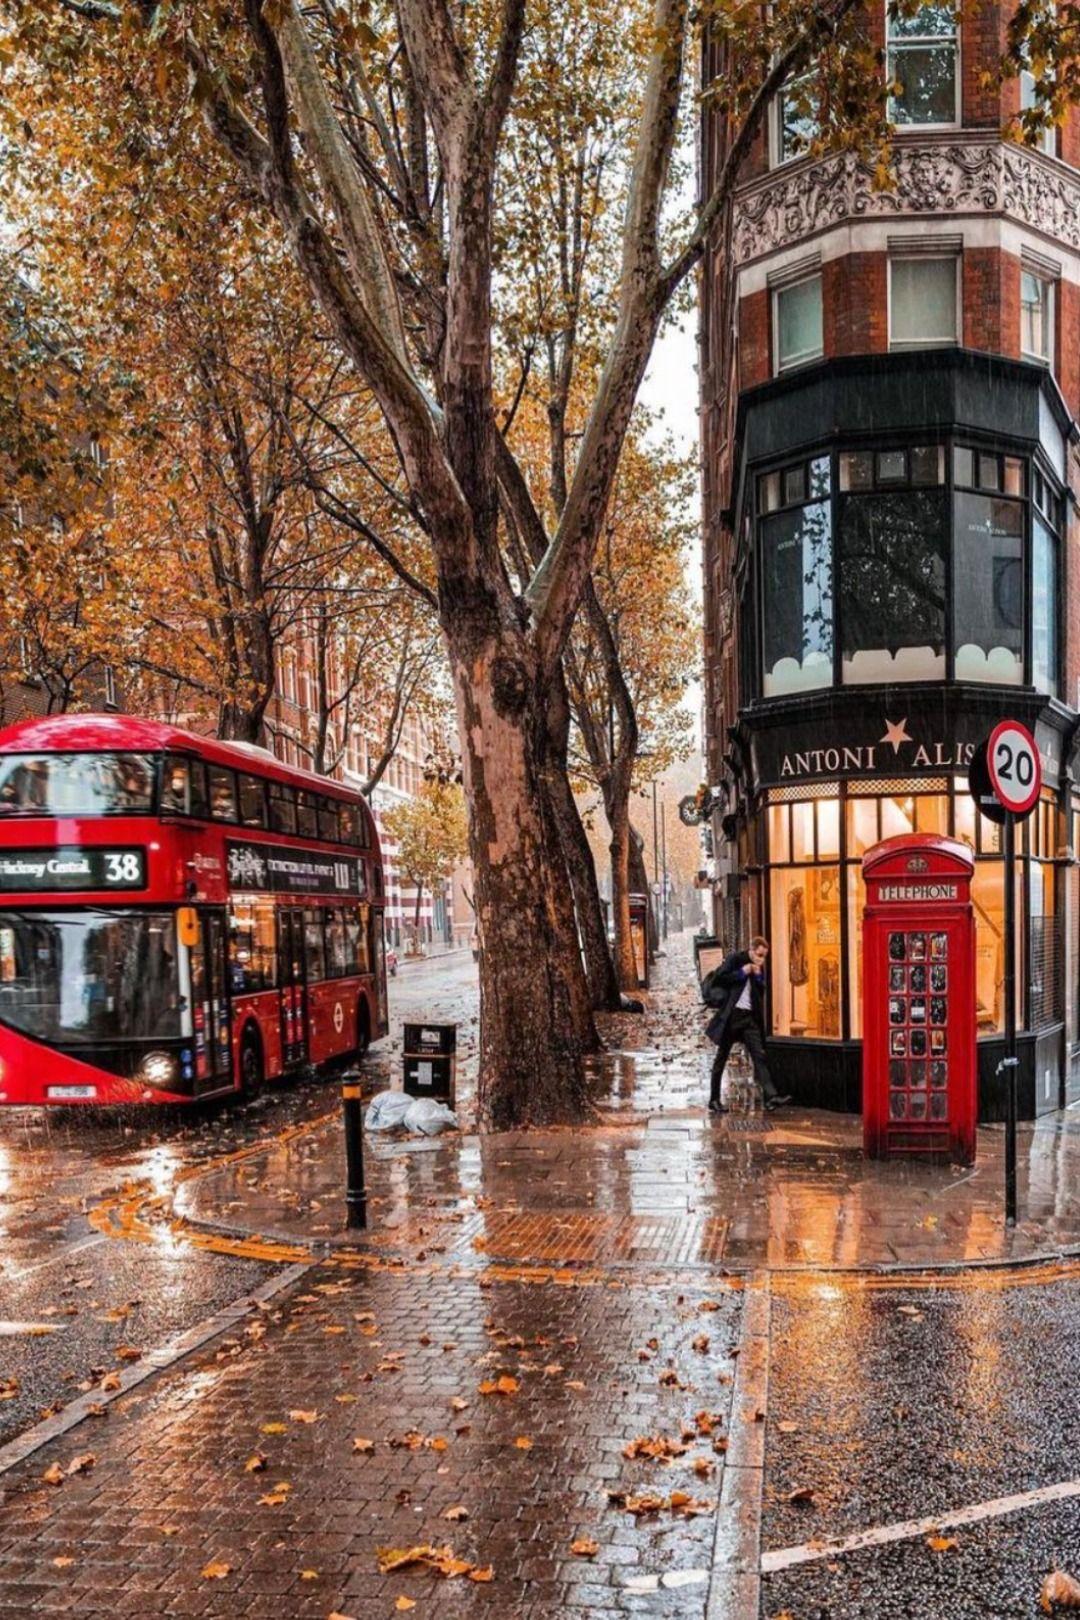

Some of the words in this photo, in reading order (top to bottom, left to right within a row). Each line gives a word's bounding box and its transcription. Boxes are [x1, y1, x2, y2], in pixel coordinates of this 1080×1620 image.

[781, 746, 875, 776] ANTONI
[911, 742, 976, 767] ALIS
[997, 743, 1033, 787] 20
[104, 854, 140, 881] 38
[880, 884, 957, 900] TELEPHONE
